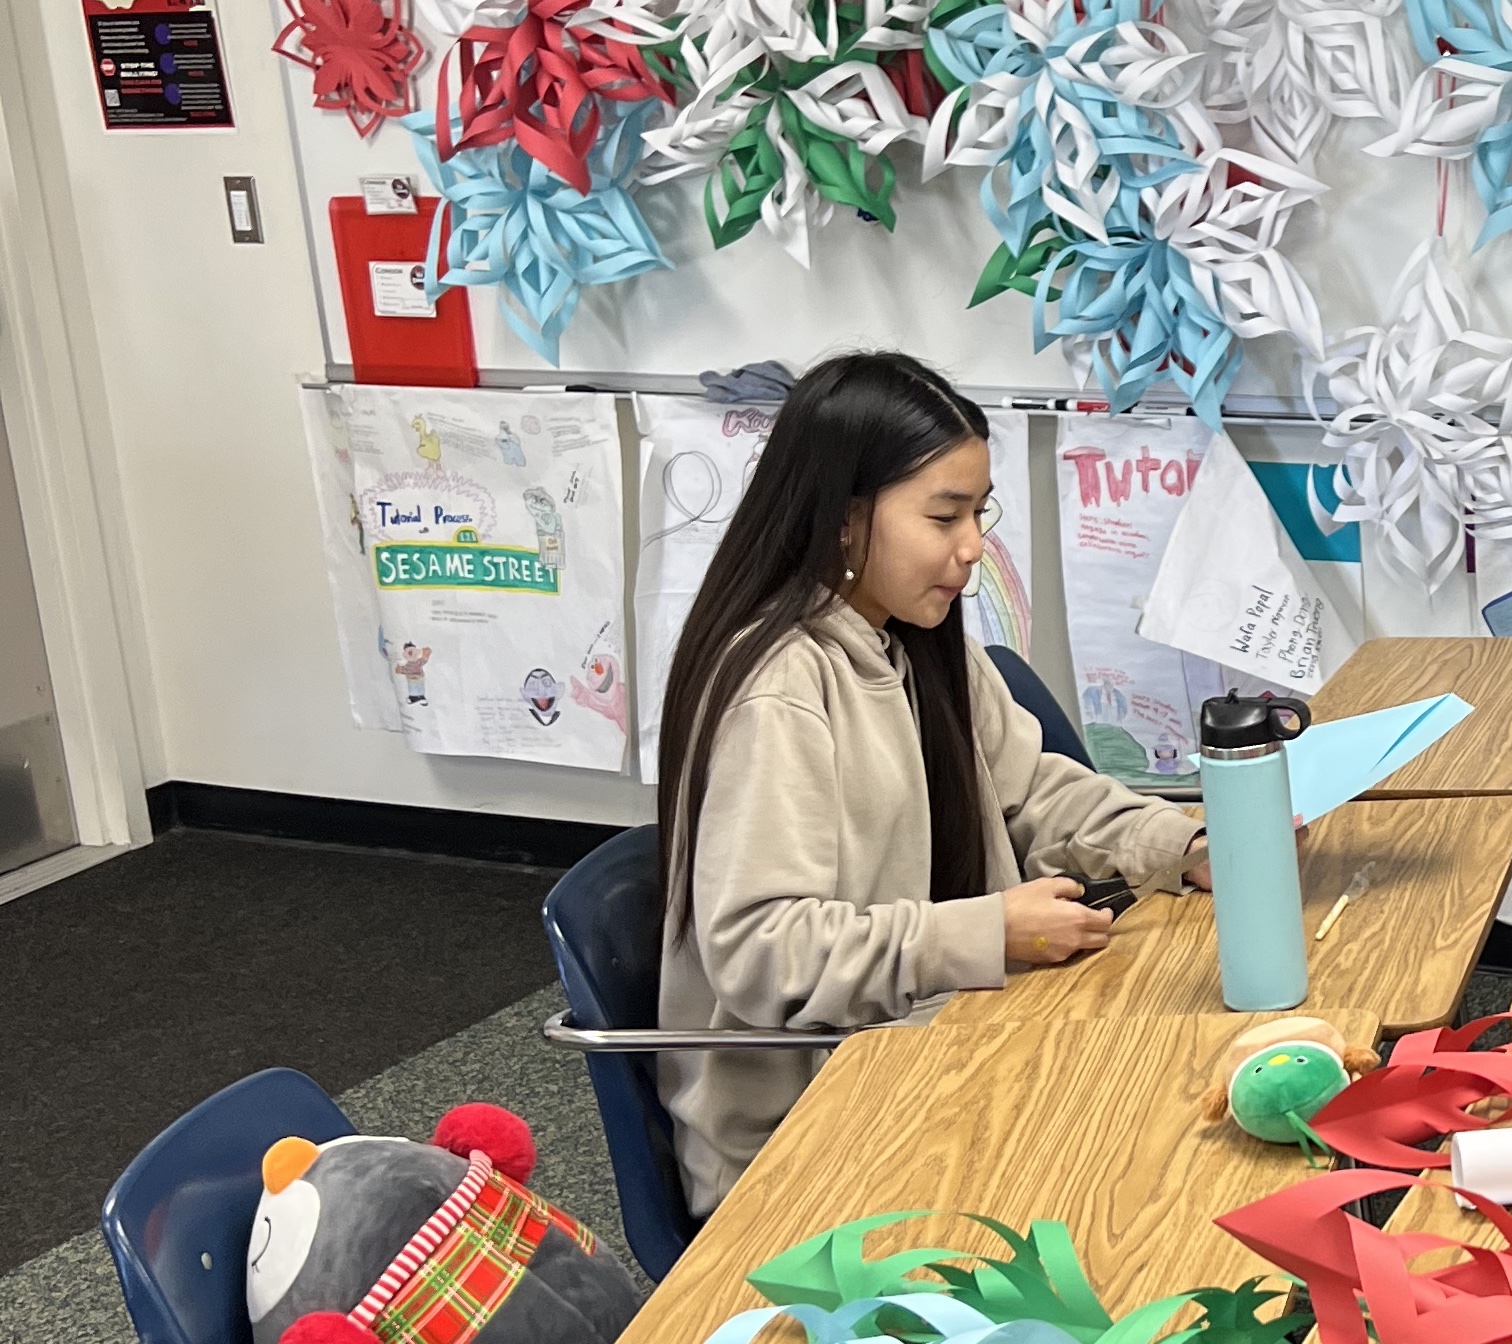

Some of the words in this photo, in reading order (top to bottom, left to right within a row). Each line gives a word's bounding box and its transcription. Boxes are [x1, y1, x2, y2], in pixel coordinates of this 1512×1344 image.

[376, 501, 421, 527] Tutorial
[380, 552, 475, 584] SESAME
[483, 556, 557, 584] STREET
[1290, 637, 1315, 678] Brian
